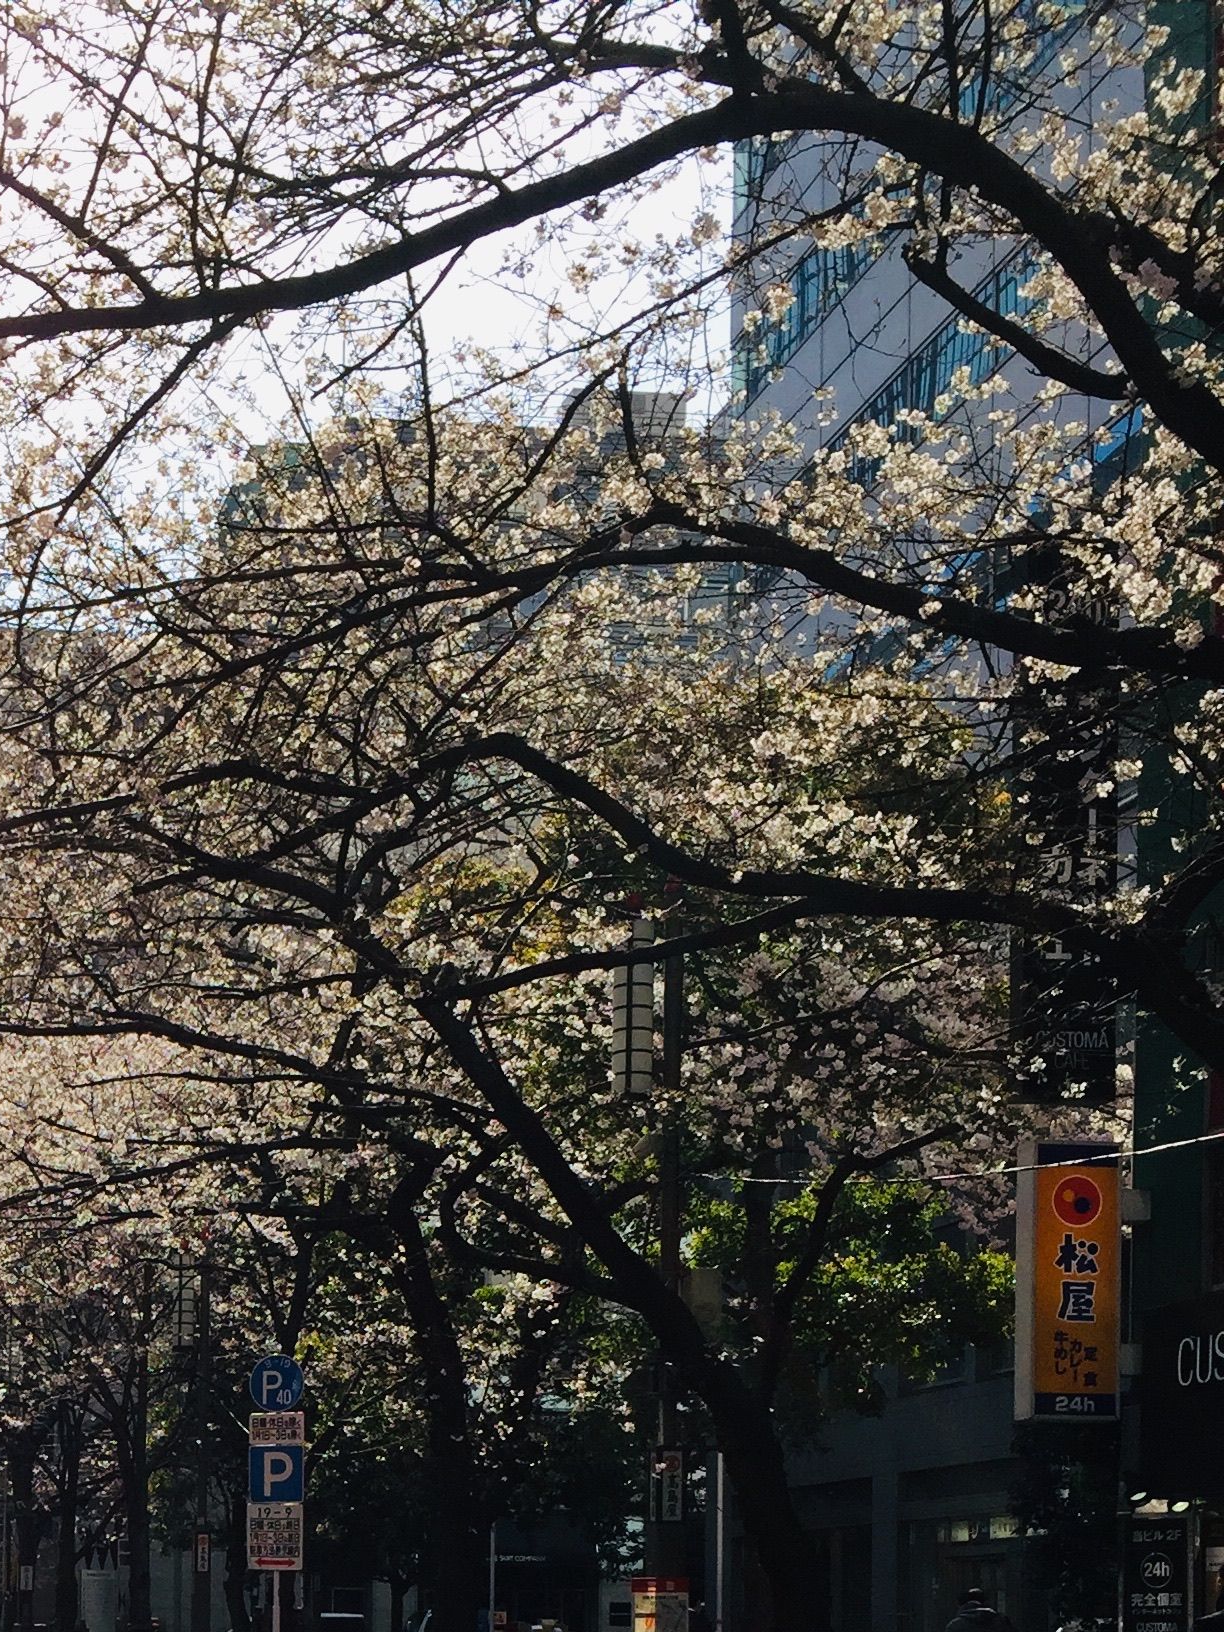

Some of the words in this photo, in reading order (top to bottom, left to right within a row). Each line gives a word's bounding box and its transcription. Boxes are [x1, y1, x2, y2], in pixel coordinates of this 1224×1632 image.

[1054, 1232, 1100, 1323] 松屋
[262, 1371, 283, 1405] P
[276, 1389, 292, 1405] 40
[1055, 1397, 1095, 1413] 24h
[263, 1451, 294, 1497] P
[1143, 1561, 1170, 1577] 24h
[1131, 1592, 1182, 1606] 完全個室
